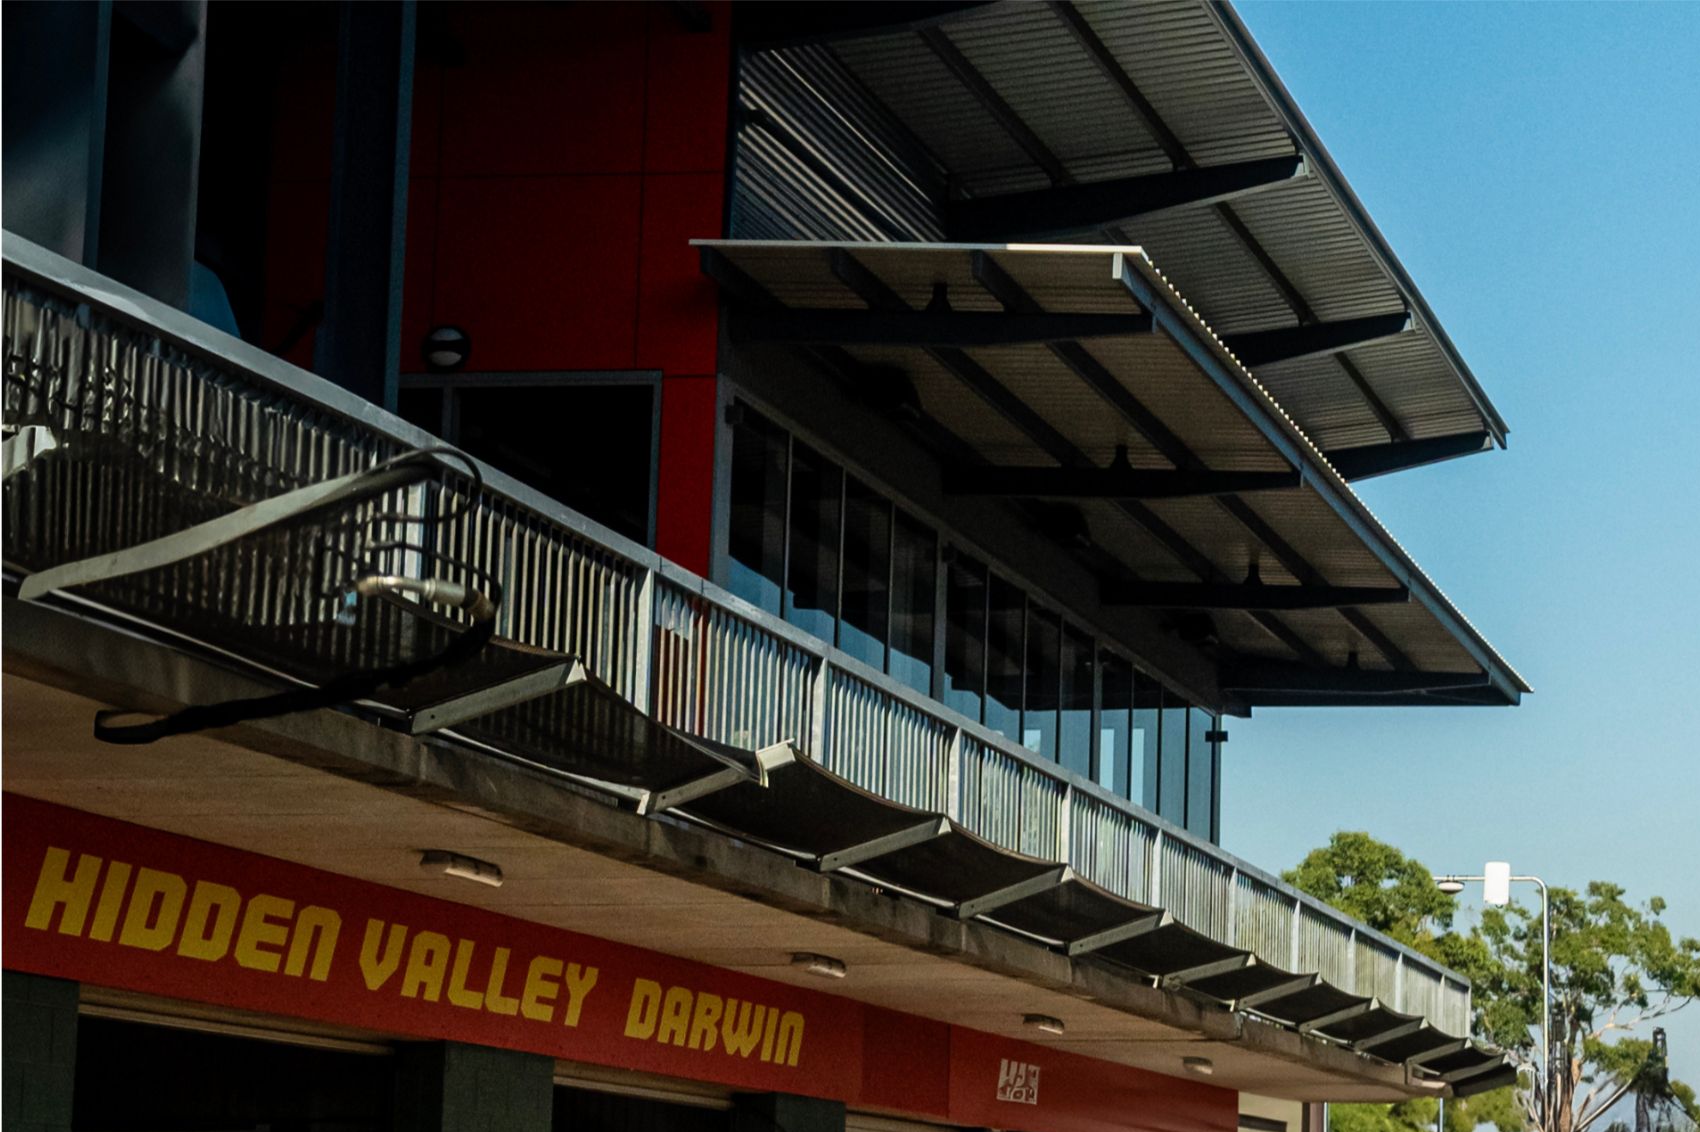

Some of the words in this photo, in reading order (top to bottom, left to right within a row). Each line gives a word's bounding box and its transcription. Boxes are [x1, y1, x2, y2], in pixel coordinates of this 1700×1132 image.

[25, 846, 341, 981] HIDDEN
[359, 918, 599, 1027] VALLEY
[625, 978, 806, 1066] DARWIN
